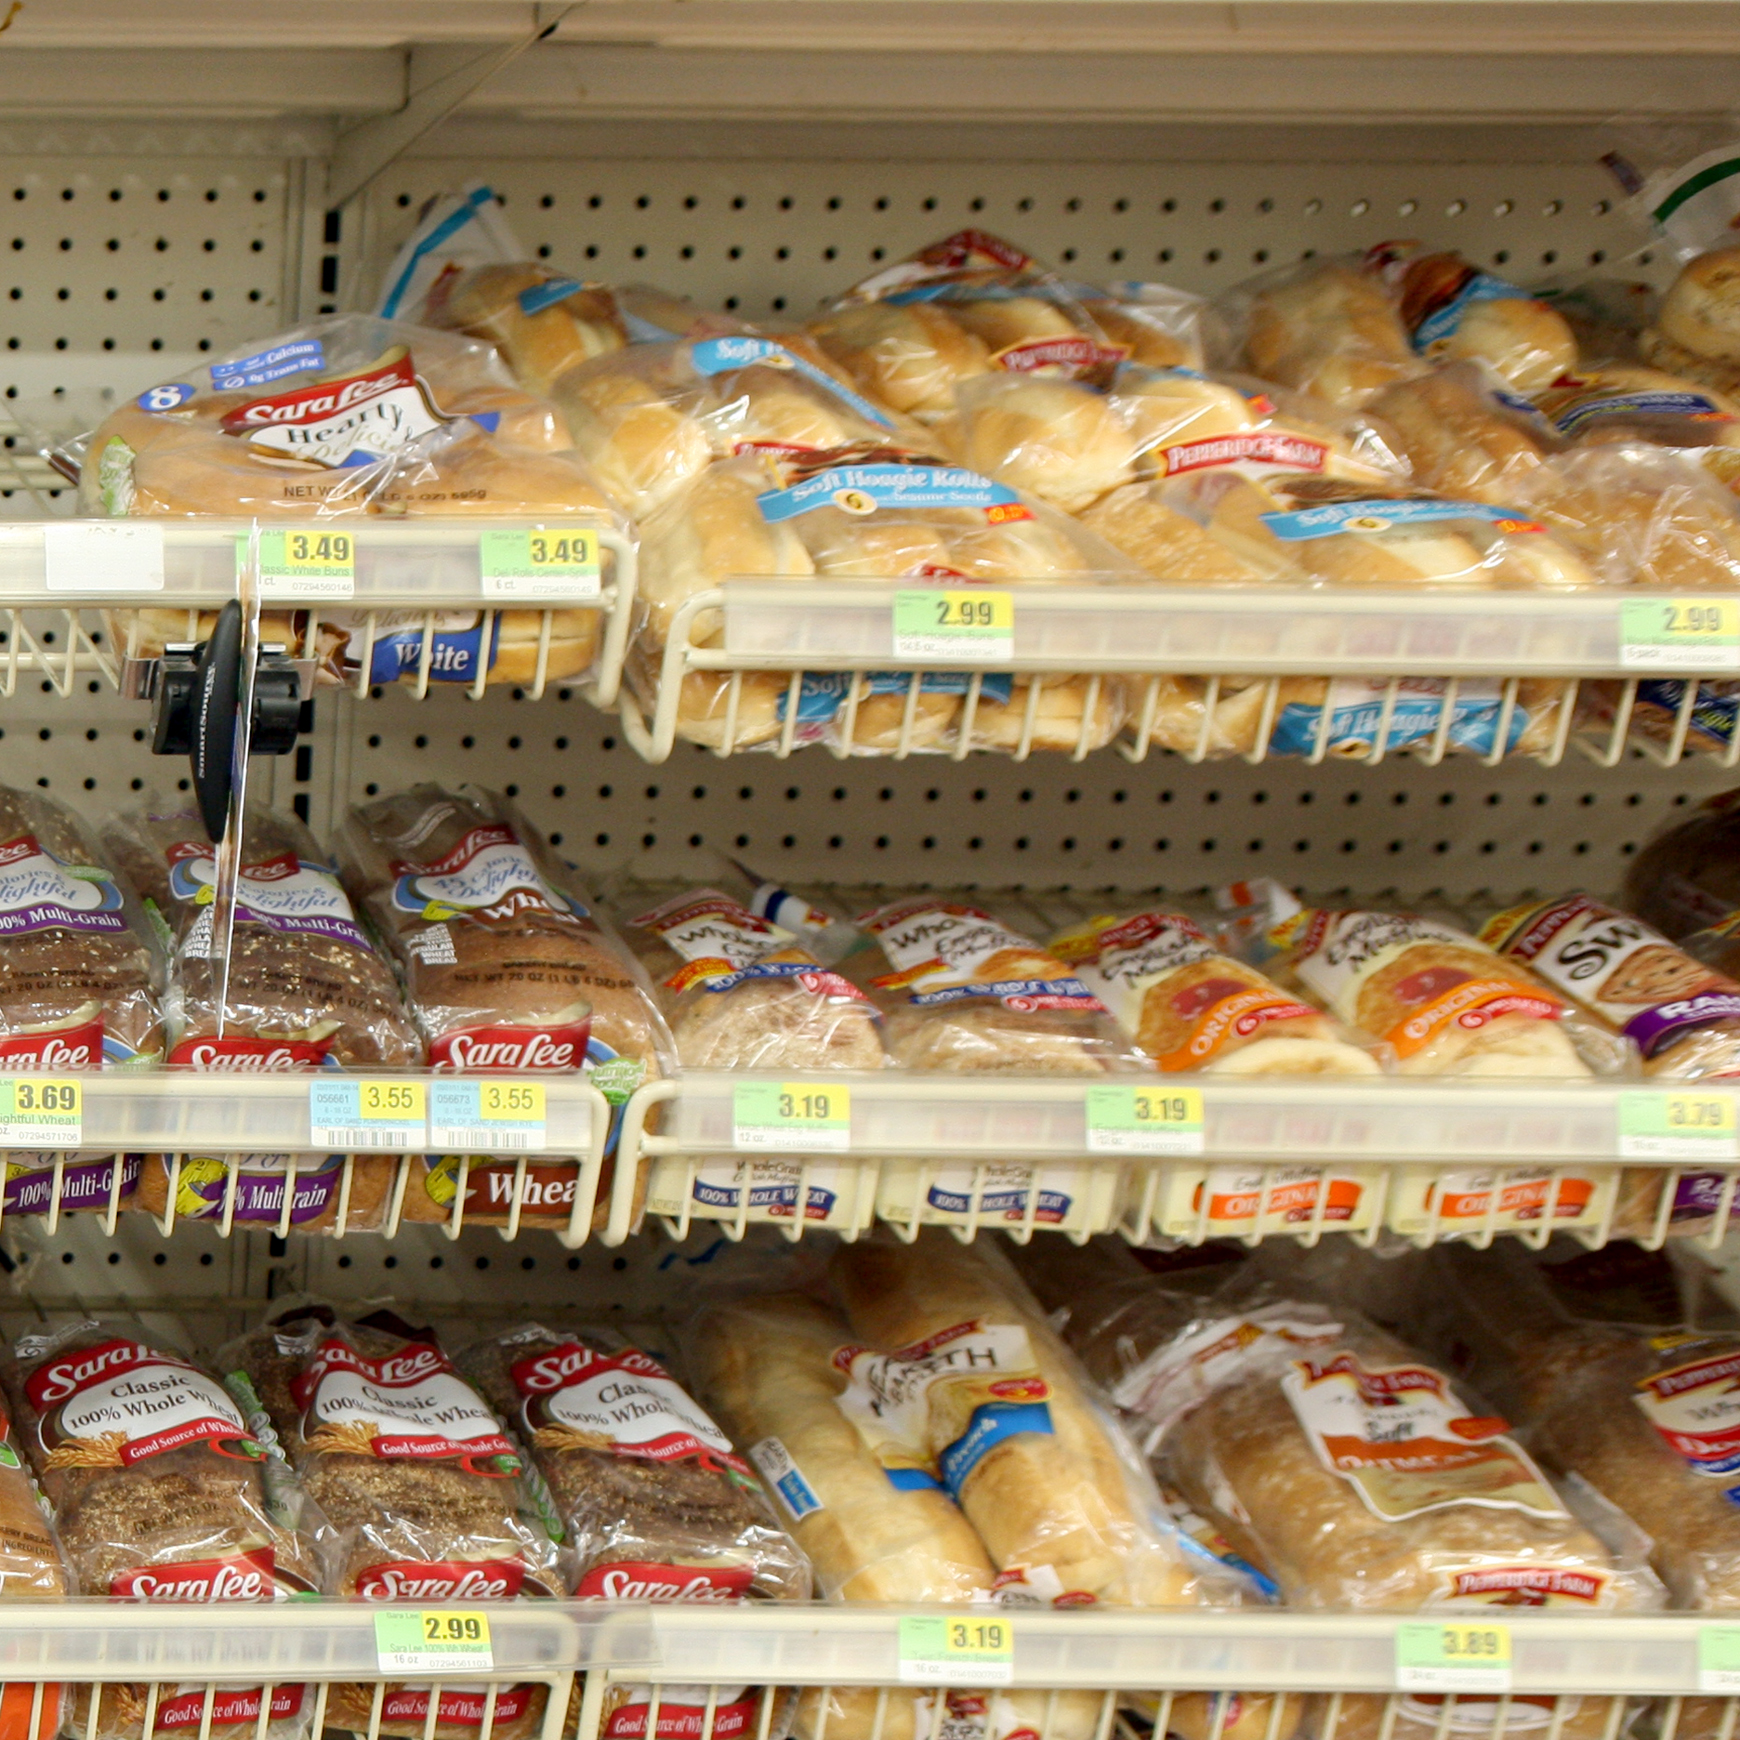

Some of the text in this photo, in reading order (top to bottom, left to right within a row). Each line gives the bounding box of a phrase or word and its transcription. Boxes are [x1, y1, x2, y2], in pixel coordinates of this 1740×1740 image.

[159, 388, 181, 409] 8
[246, 372, 398, 423] Sara Lee
[287, 403, 404, 444] Hearty
[292, 536, 349, 561] 3.49
[532, 539, 588, 563] 3.49
[937, 601, 993, 626] 2.99
[1664, 606, 1722, 631] 2.99
[30, 906, 122, 928] Multi-Grain
[450, 1030, 575, 1069] Sara Lee
[18, 1085, 76, 1110] 3.69
[368, 1087, 413, 1108] 3.55
[488, 1088, 533, 1109] 3.55
[779, 1094, 829, 1118] 3.19
[1135, 1096, 1185, 1121] 3.19
[39, 1114, 76, 1126] Wheat
[425, 1618, 480, 1639] 2.99
[953, 1624, 1002, 1648] 3.19
